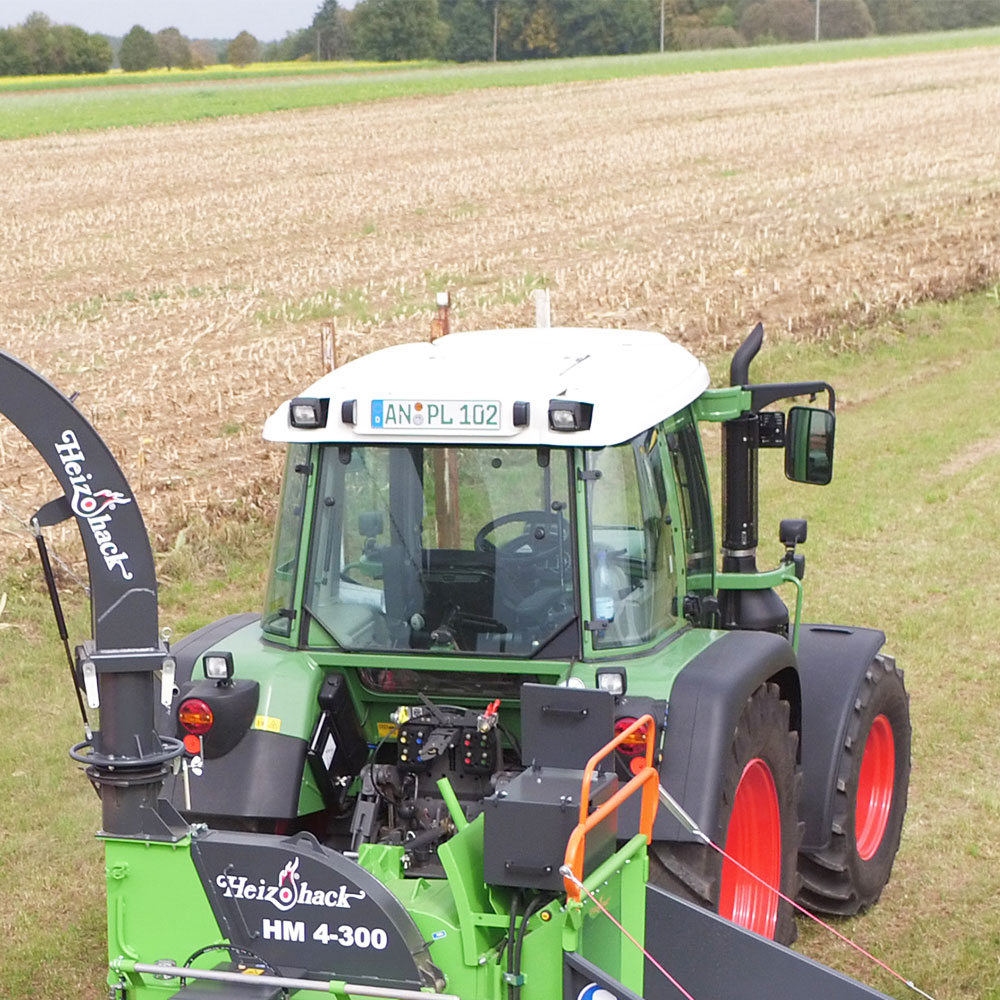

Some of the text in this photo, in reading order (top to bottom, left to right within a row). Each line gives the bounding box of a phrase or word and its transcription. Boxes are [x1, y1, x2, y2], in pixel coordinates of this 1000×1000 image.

[385, 404, 497, 425] AN PL 102
[262, 918, 388, 950] HM 4-300
